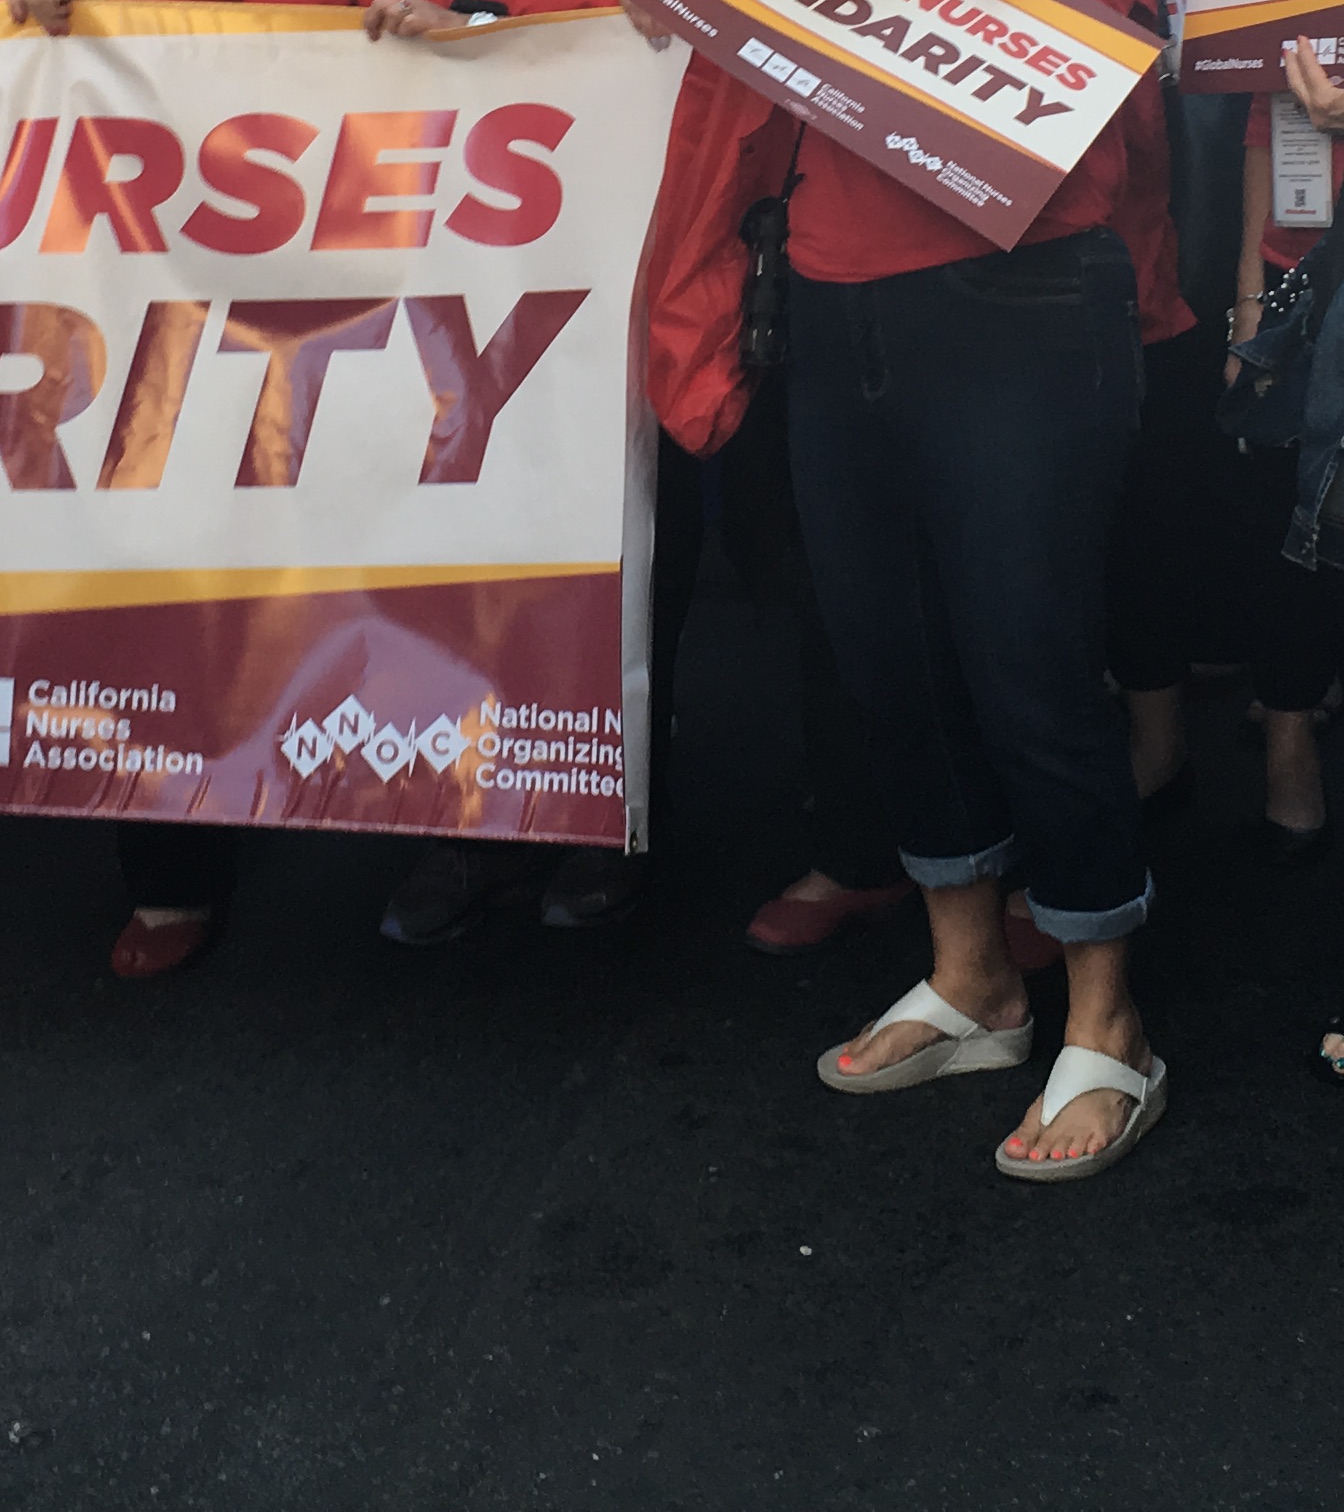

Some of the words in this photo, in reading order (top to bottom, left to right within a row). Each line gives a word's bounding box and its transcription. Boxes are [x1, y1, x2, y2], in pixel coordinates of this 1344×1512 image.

[28, 679, 177, 713] California
[25, 709, 131, 741] Nurses
[480, 701, 599, 734] National
[604, 707, 623, 737] N
[22, 740, 204, 776] Association
